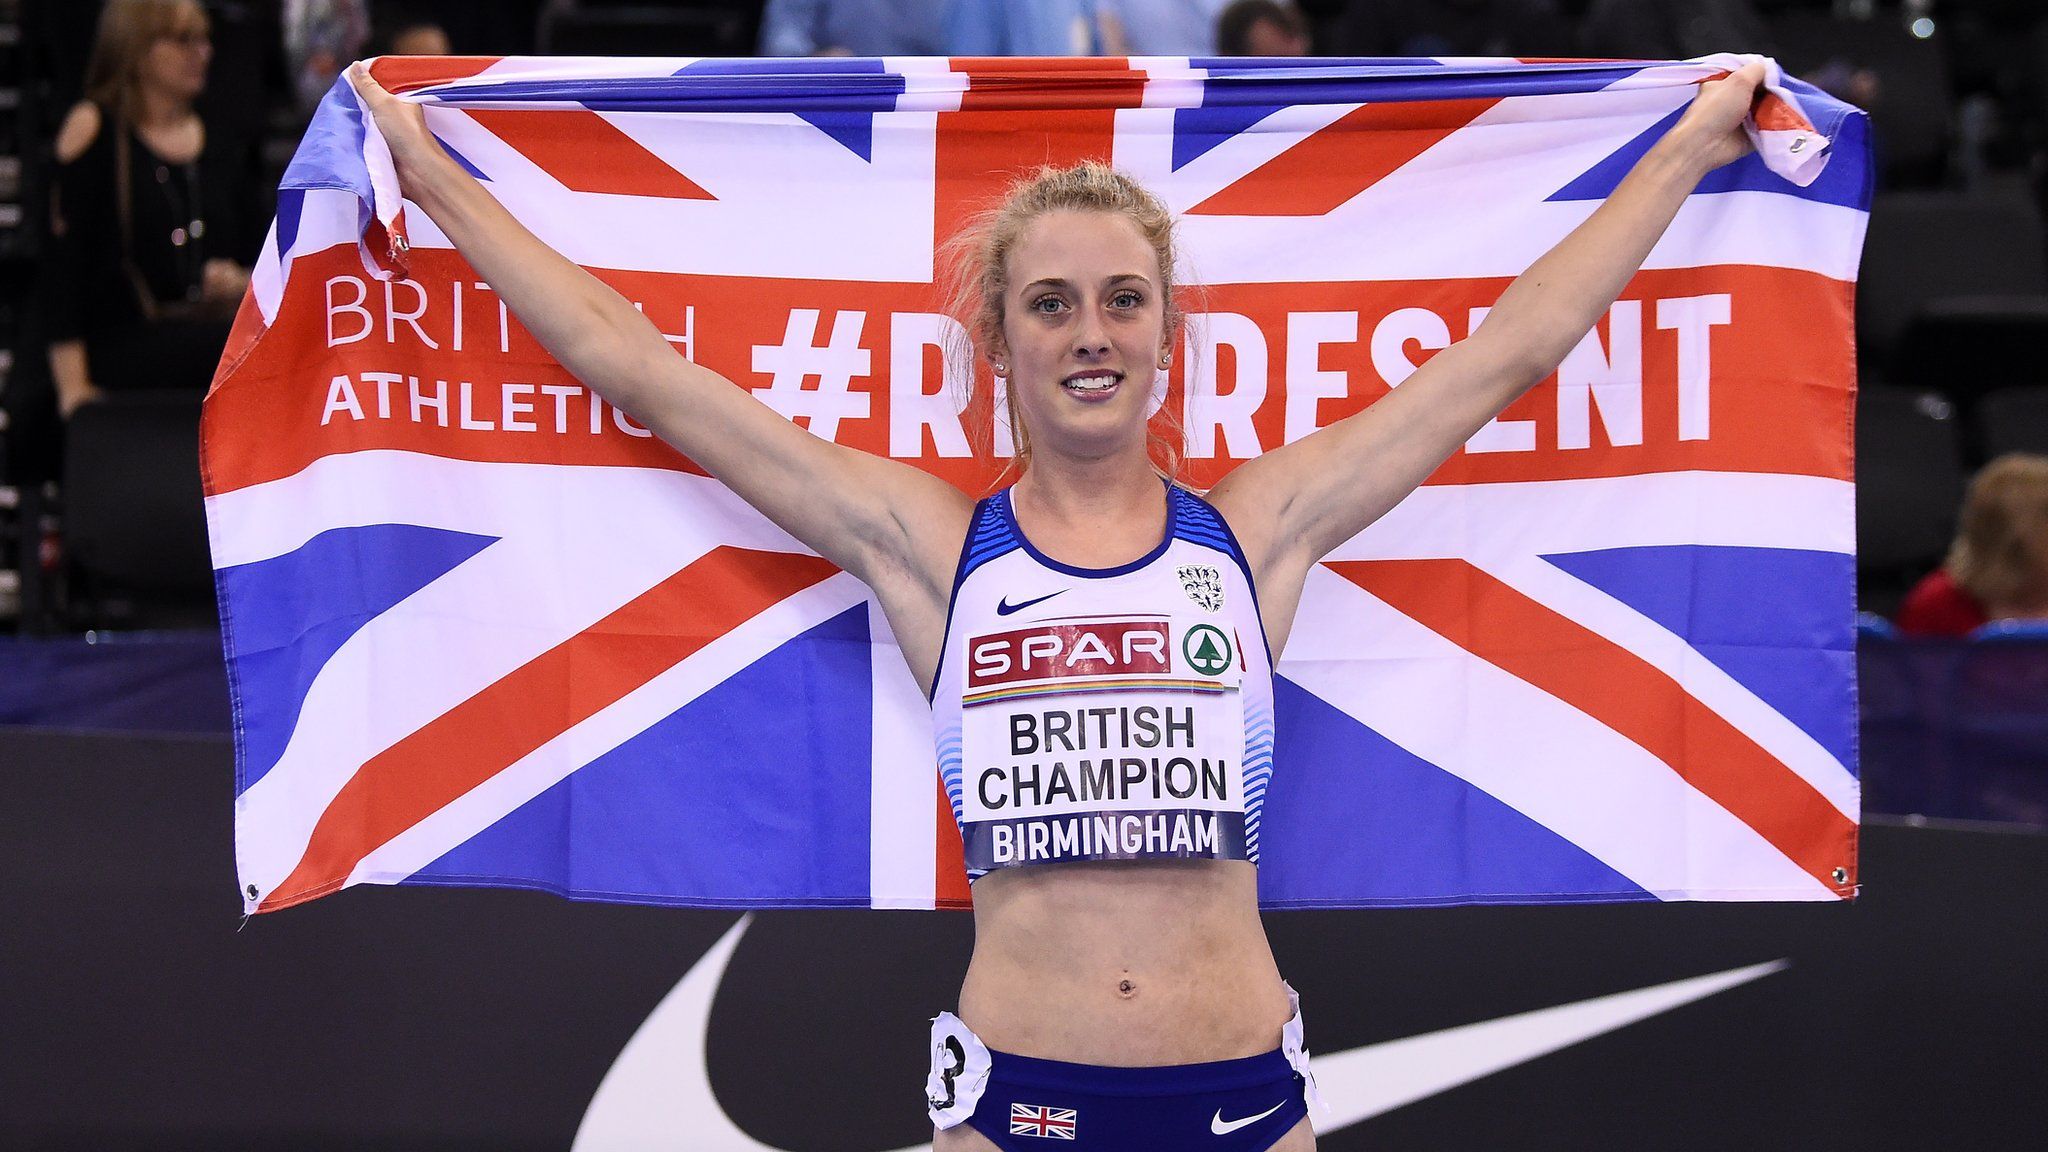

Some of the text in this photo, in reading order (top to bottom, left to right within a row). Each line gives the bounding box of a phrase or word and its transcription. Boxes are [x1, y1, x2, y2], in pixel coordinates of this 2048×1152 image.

[326, 275, 695, 364] BRITH
[320, 371, 655, 438] ATHLETIC
[974, 630, 1166, 678] SPAR
[1009, 705, 1194, 756] BRITISH
[977, 757, 1228, 810] CHAMPION
[992, 814, 1219, 864] BIRMINGHAM
